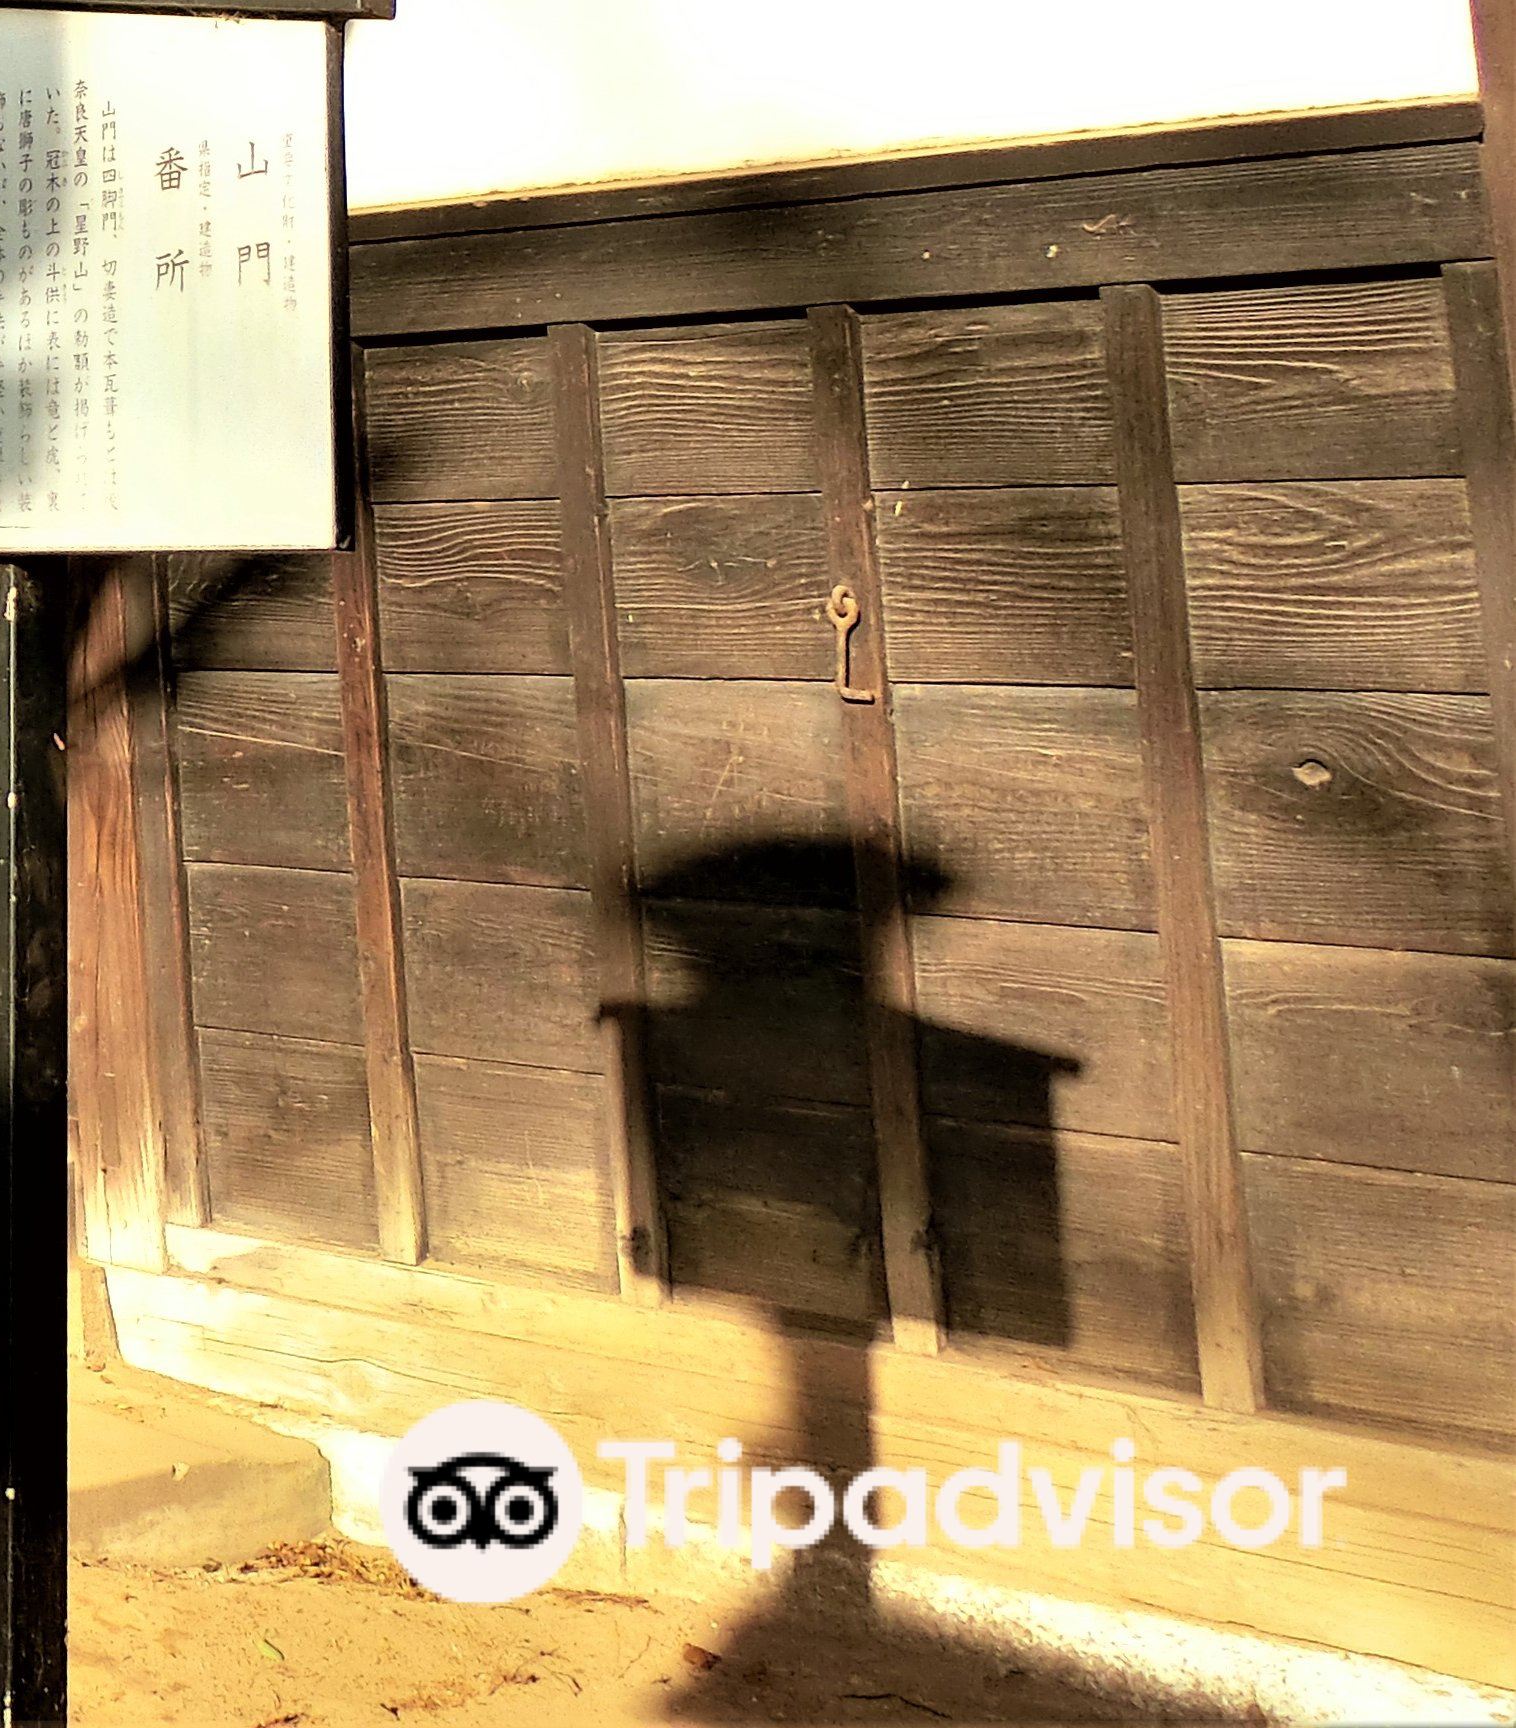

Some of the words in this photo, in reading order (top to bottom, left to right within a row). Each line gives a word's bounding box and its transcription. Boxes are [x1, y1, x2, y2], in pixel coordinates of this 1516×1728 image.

[155, 147, 190, 293] 番所
[198, 140, 216, 278] 県指定・建造物
[236, 141, 272, 288] 山門
